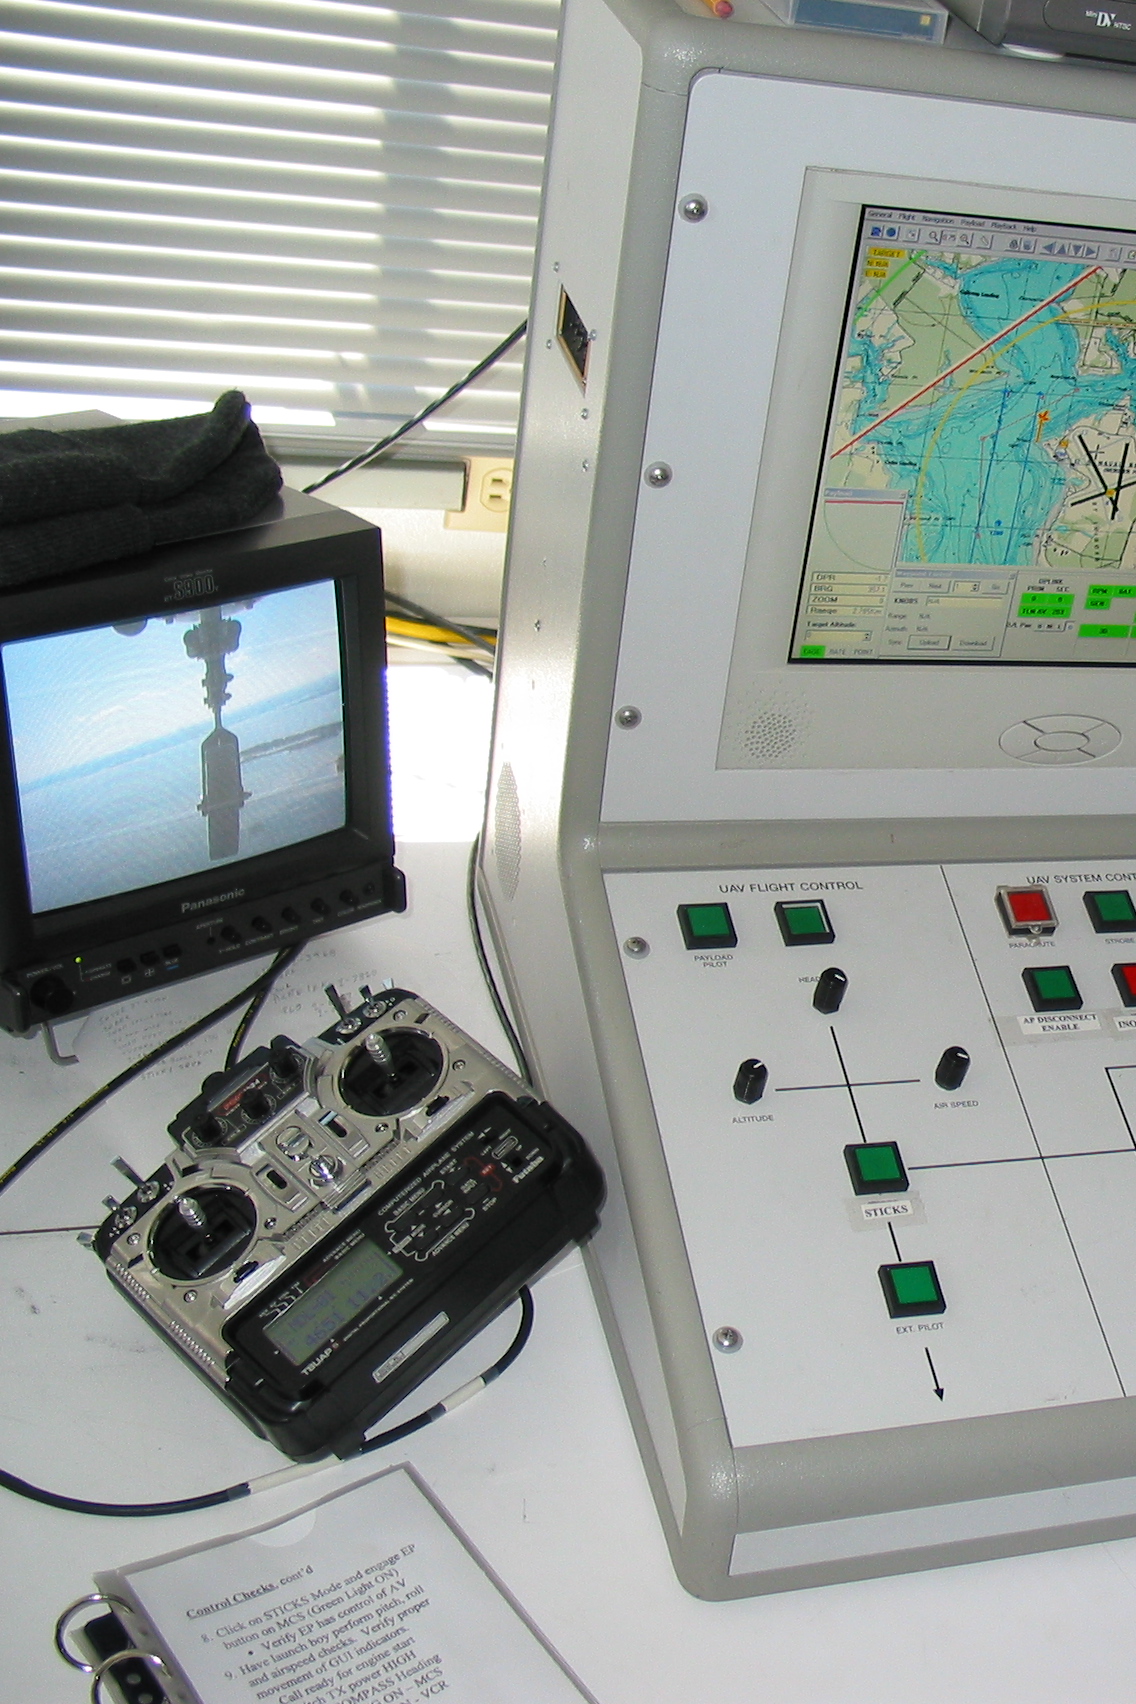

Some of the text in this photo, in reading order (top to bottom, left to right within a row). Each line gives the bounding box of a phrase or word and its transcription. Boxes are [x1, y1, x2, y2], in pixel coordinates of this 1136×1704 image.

[1096, 12, 1116, 27] DV
[1114, 22, 1131, 31] NTSC
[719, 880, 864, 894] UAV FLIGHT CONTROL
[1026, 875, 1050, 885] UAV
[1053, 873, 1102, 884] SYSTEM
[180, 886, 246, 914] Panasonic
[1105, 937, 1135, 945] STROBE
[694, 954, 734, 963] PAYLOAD
[703, 961, 728, 969] PILOT
[1023, 1013, 1097, 1025] AP DISCONNECT
[1042, 1023, 1081, 1032] ENABLE
[951, 1100, 979, 1108] SPEED
[732, 1114, 774, 1124] ALTITUDE
[451, 1131, 475, 1153] SYSTEM
[511, 1155, 545, 1184] Futaba
[864, 1204, 909, 1218] STICKS
[918, 1322, 945, 1332] PILOT
[186, 1564, 314, 1621] Control Checks, cont'd
[216, 1621, 248, 1639] Click
[248, 1616, 263, 1627] on
[263, 1595, 310, 1621] STICKS
[311, 1580, 343, 1602] Mode
[344, 1570, 364, 1587] and
[363, 1553, 401, 1577] engage
[400, 1543, 416, 1557] EP
[223, 1567, 400, 1650] button on MCS (Green Light ON)
[260, 1577, 408, 1654] Verify EP has control of AV
[238, 1656, 270, 1677] Have
[270, 1640, 309, 1663] launch
[308, 1630, 331, 1651] boy
[331, 1609, 376, 1640] perform
[374, 1596, 407, 1622] pitch,
[405, 1583, 426, 1602] roll
[248, 1597, 432, 1688] and airspeed checks. Verify proper
[256, 1624, 410, 1702] movement of GUI indicators.
[304, 1674, 336, 1697] ready
[336, 1667, 354, 1681] for
[354, 1649, 392, 1676] engine
[392, 1634, 418, 1654] start
[396, 1652, 443, 1684] Heading
[326, 1648, 418, 1702] TX power HIGH
[413, 1666, 444, 1689] MCS
[420, 1680, 450, 1700] VCR
